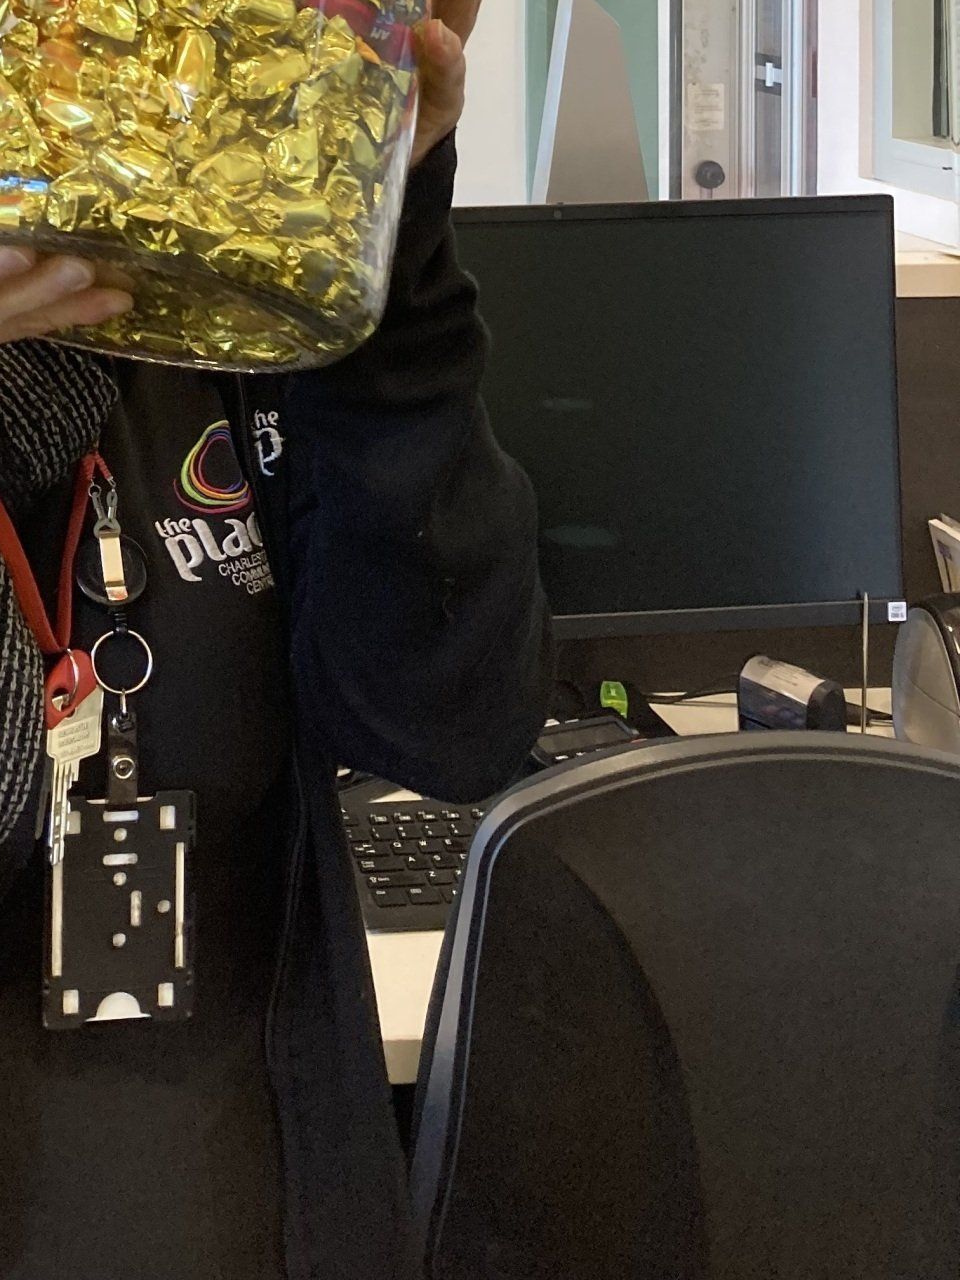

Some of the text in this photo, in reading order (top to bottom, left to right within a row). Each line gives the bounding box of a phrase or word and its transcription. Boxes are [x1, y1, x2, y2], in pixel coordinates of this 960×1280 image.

[253, 409, 279, 428] he
[155, 518, 191, 538] the
[218, 550, 269, 576] CHARLEST
